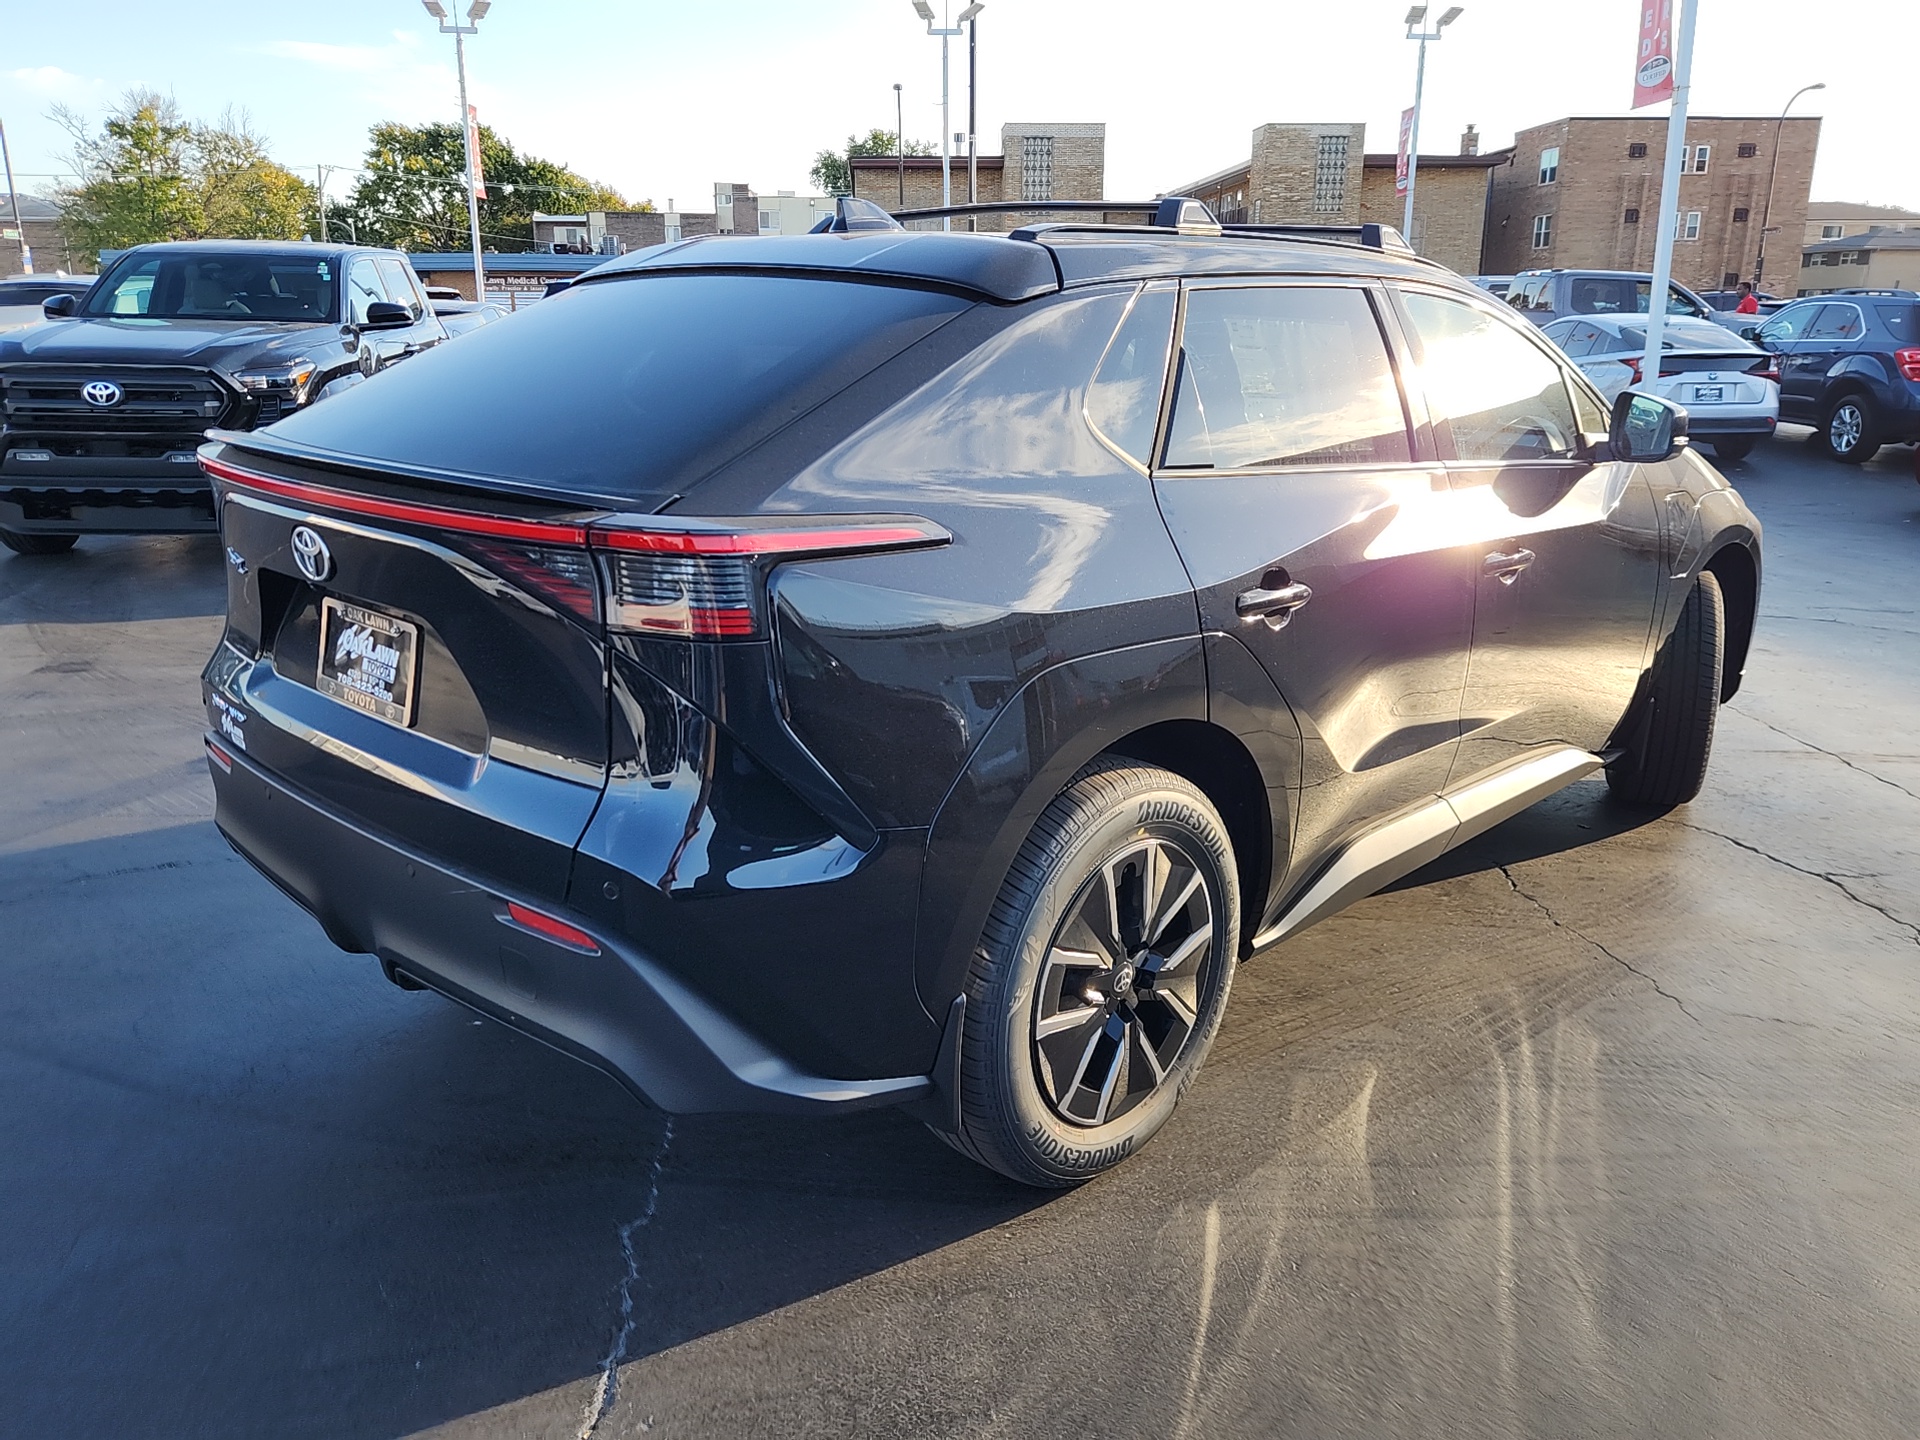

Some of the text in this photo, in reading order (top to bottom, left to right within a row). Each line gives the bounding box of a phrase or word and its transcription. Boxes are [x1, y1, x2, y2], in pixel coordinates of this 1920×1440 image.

[506, 276, 539, 285] Medical
[347, 606, 390, 631] OAK LAWN
[366, 660, 392, 680] TOYOTA
[343, 687, 377, 712] TOYOTA
[1134, 799, 1228, 866] BRIDGESTONE
[1025, 1121, 1135, 1171] BRIDGESTONE
